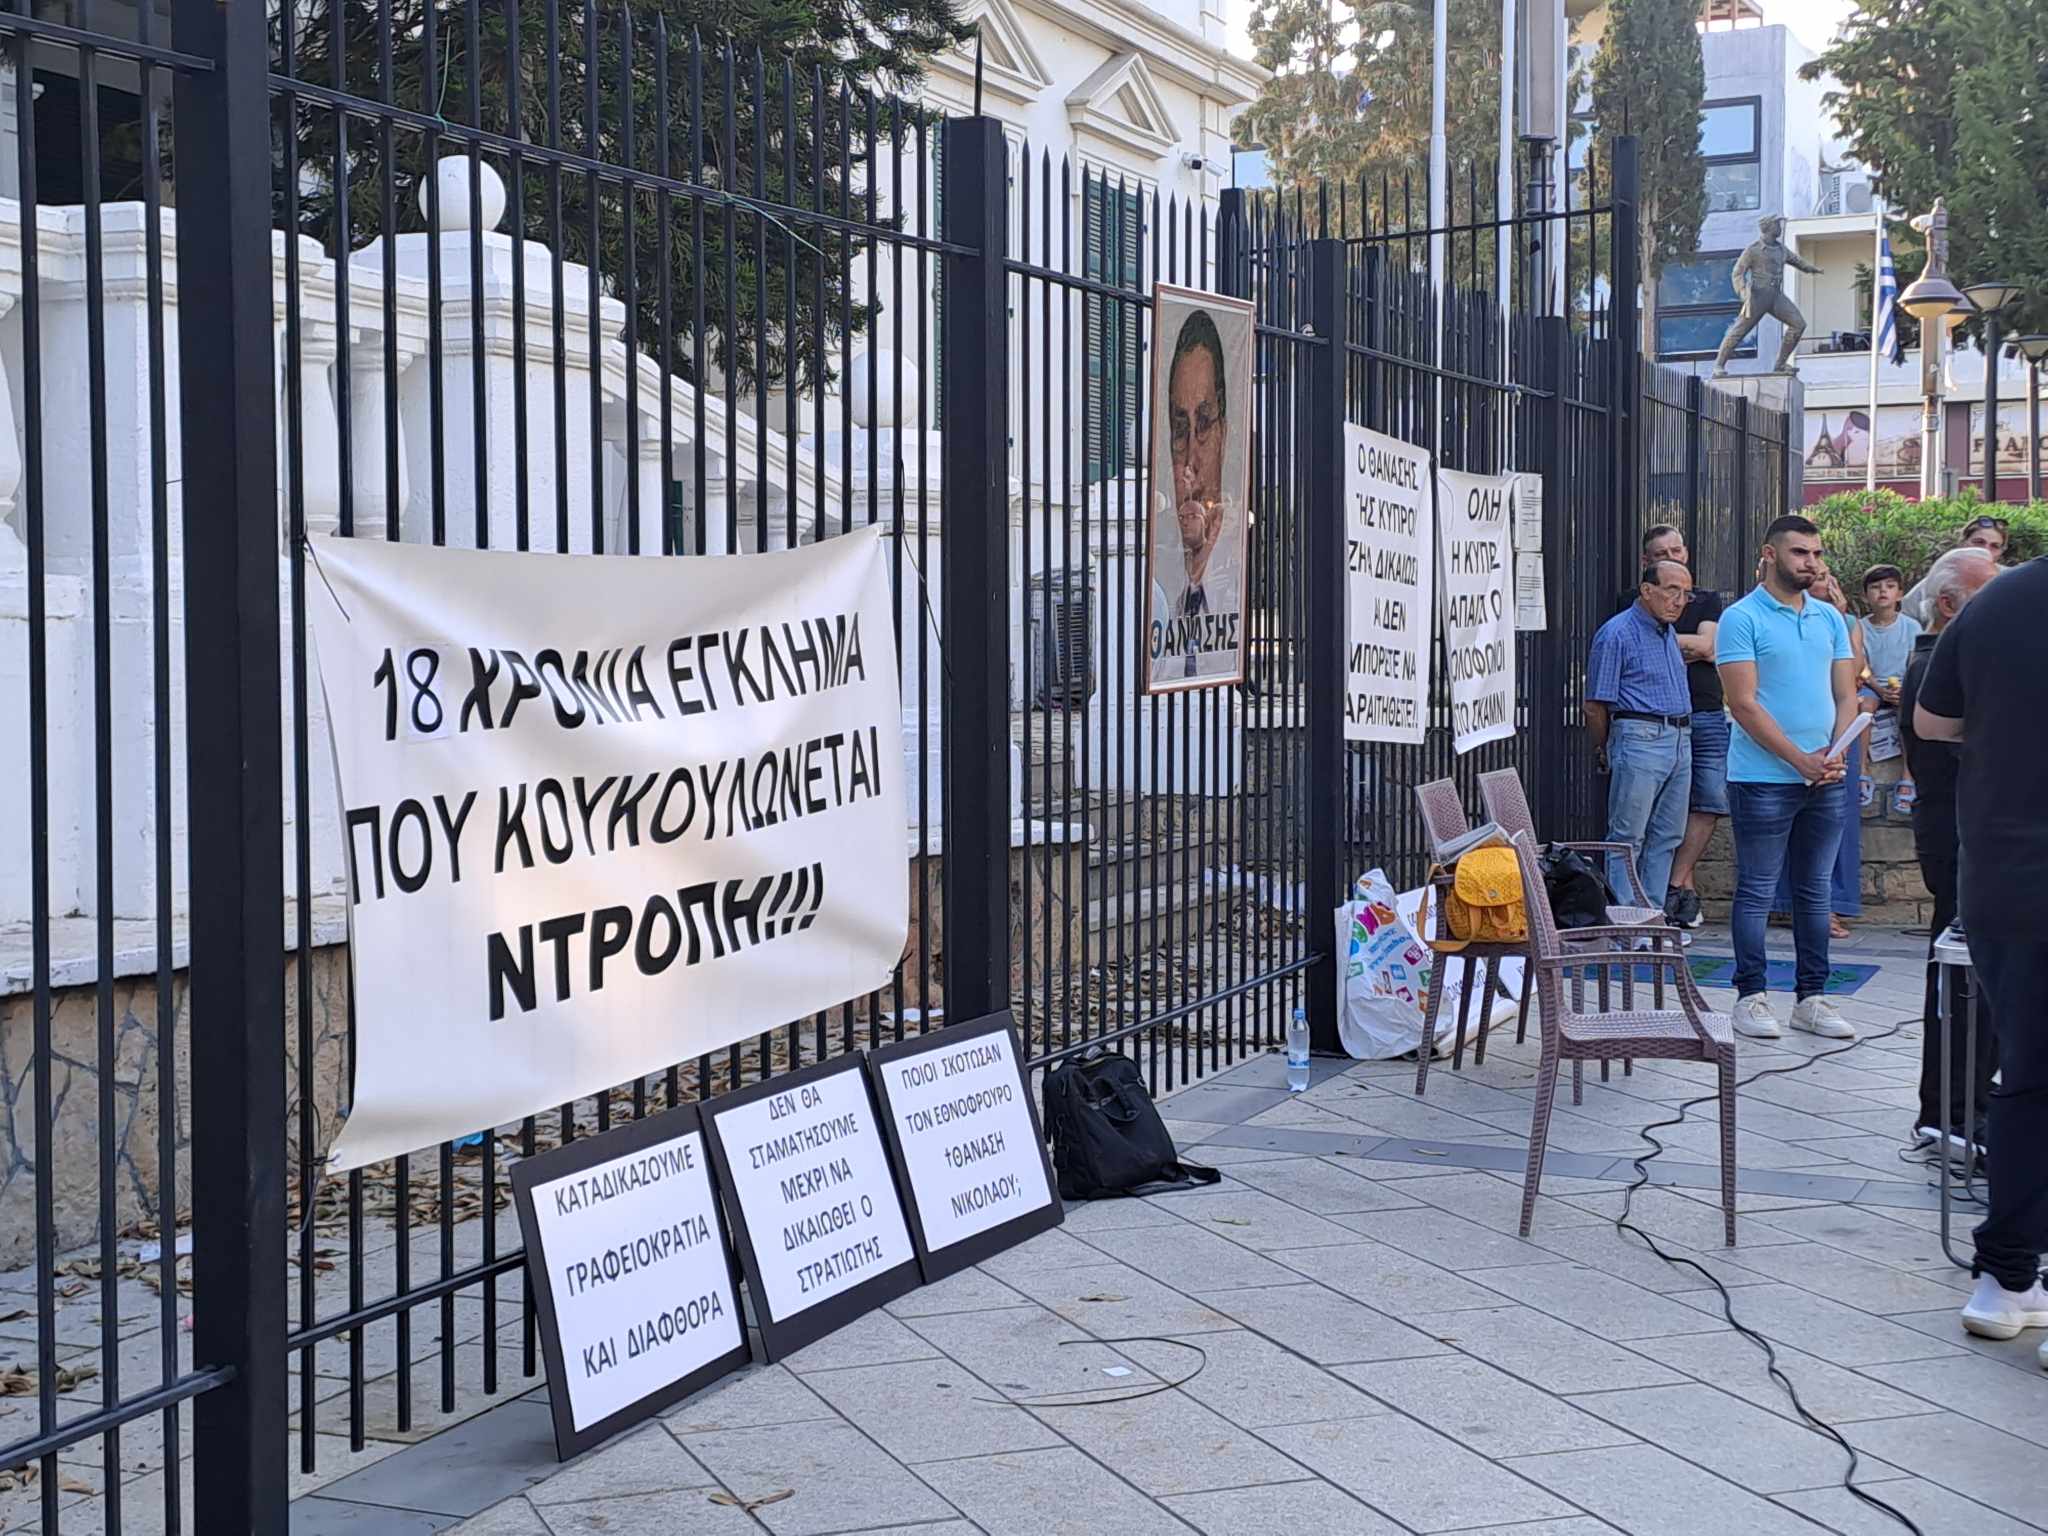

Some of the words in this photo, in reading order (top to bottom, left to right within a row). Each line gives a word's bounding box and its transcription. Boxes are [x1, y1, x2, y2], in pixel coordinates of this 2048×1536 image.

[1358, 443, 1366, 475] Ο
[1369, 446, 1419, 490] ΘΑΝΑΣΗΣ
[1356, 492, 1375, 527] ΗΣ
[1468, 487, 1502, 522] ΟΛΗ
[1451, 540, 1461, 574] Η
[1151, 612, 1239, 660] ΘΑΝΑΣΗΣ
[1383, 599, 1407, 632] ΔΕΝ
[373, 647, 444, 741] 18
[459, 644, 665, 733] ΧΡΟΝΙΑ
[666, 611, 866, 716] ΕΓΚΛΗΜΑ
[1402, 651, 1417, 681] ΝΑ
[1472, 690, 1506, 732] ΣΚΑΜΝΙ
[346, 790, 479, 906] ΠΟΥ
[493, 726, 882, 874] ΚΟΥΚΟΥΛΩΝΕΤΑΙ
[487, 862, 824, 1022] ΝΤΡΟΠΗ!!!
[901, 1062, 938, 1090] ΠΟΙΟΙ
[941, 1042, 1002, 1079] ΣΚΟΤΩΣΑΝ
[768, 1093, 798, 1121] ΔΕΝ
[801, 1085, 823, 1109] ΘΑ
[905, 1109, 933, 1135] ΤΟΝ
[934, 1083, 1013, 1126] ΕΘΝΟΦΡΟΥΡΟ
[748, 1112, 859, 1170] ΣΤΑΜΑΤΗΣΟΥΜΕ
[554, 1144, 695, 1217] ΚΑΤΑΔΙΚΑΖΟΥΜΕ
[780, 1165, 829, 1204] ΜΕΧΡΙ
[829, 1157, 854, 1190] ΝΑ
[951, 1173, 1023, 1219] ΝΙΚΟΛΑΟΥ;
[782, 1200, 857, 1252] ΔΙΚΑΙΩΘΕΙ
[860, 1194, 873, 1218] Ο
[565, 1213, 711, 1297] ΓΡΑΦΕΙΟΚΡΑΤΙΑ
[797, 1235, 883, 1294] ΣΤΡΑΤΙΩΤΗΣ
[582, 1336, 618, 1378] ΚΑΙ
[627, 1290, 724, 1359] ΔΙΑΦΘΟΡΑ
